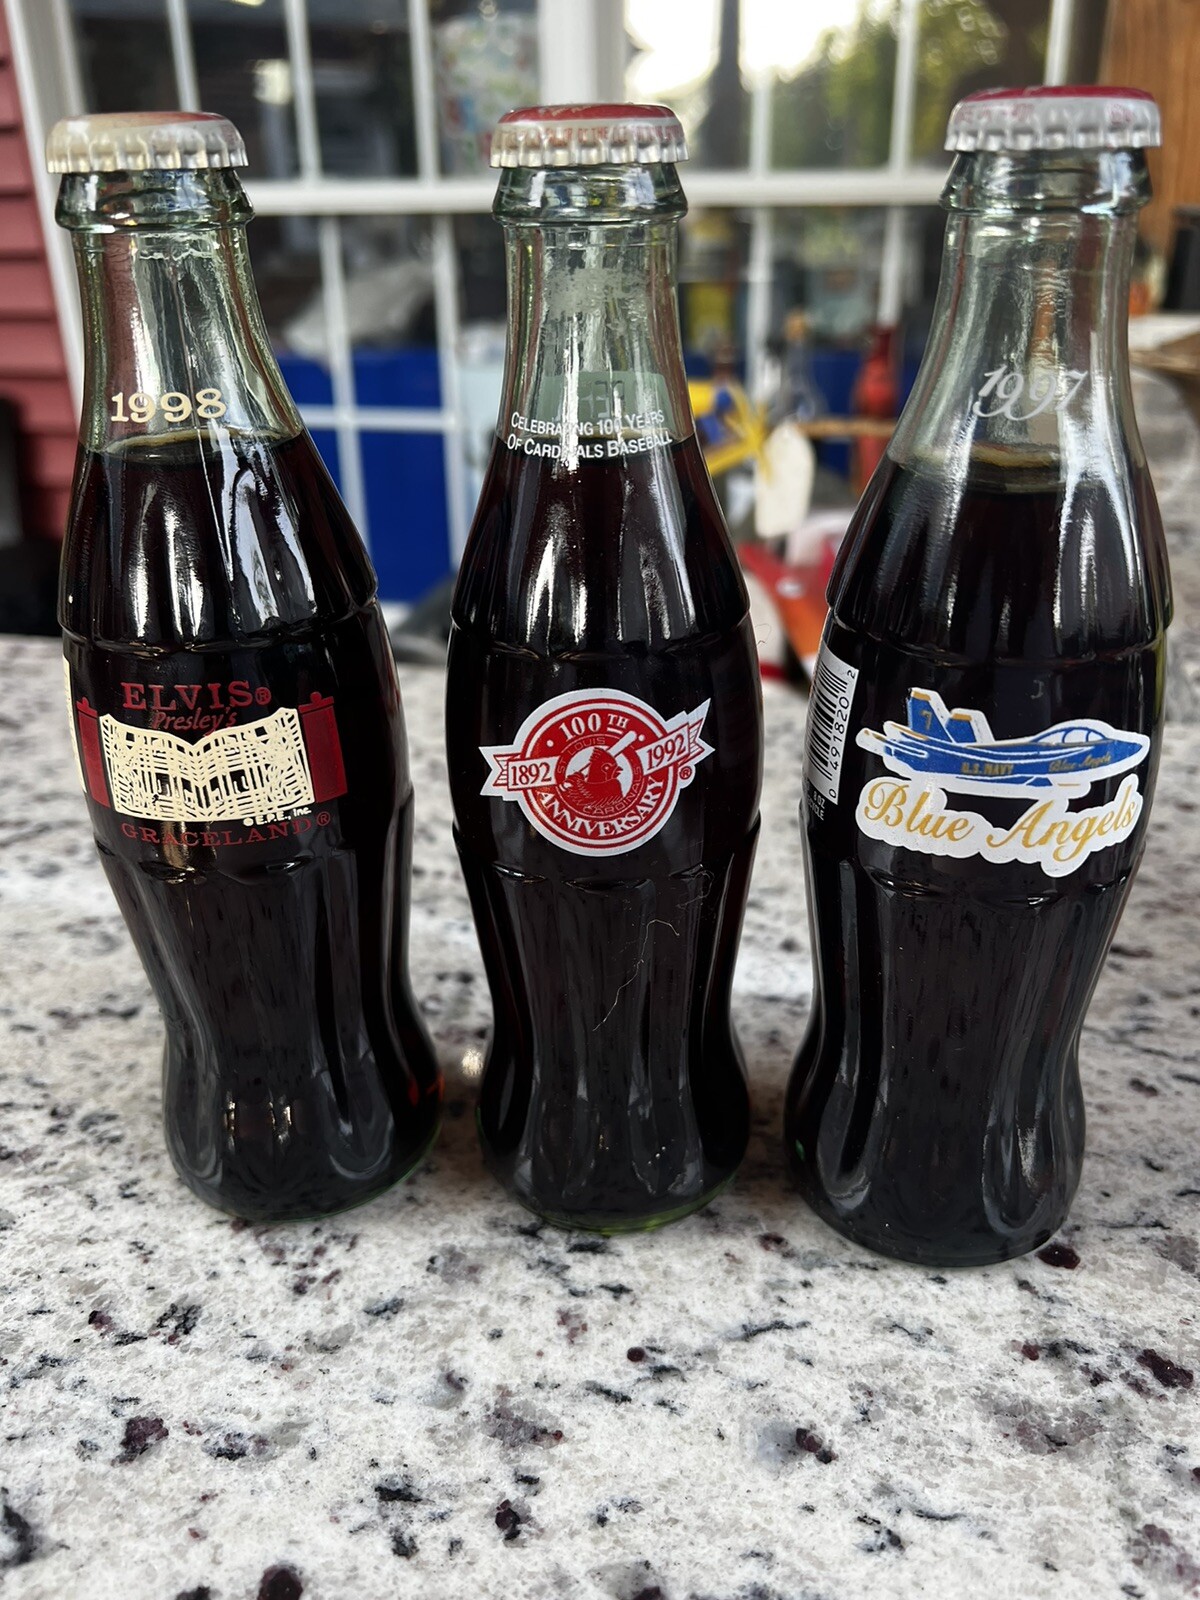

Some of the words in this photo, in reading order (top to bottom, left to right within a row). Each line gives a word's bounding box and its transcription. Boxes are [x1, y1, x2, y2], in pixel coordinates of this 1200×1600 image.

[110, 387, 227, 423] 1998
[972, 363, 1088, 421] 1997
[511, 411, 594, 436] CELEBRANG
[624, 409, 665, 430] YEARS
[507, 433, 523, 451] OF
[523, 437, 605, 459] CARDALS
[607, 430, 673, 457] BASEBALL
[150, 706, 238, 737] Presley's
[559, 712, 602, 743] 100
[607, 713, 630, 734] TH
[920, 709, 933, 731] 7
[567, 737, 606, 756] LOUIS
[646, 732, 686, 773] 1992
[510, 762, 552, 786] 1892
[582, 766, 642, 815] CARDINALS
[537, 776, 664, 838] ANNIVERSARY
[863, 780, 976, 843] Blue
[986, 784, 1137, 863] Angels
